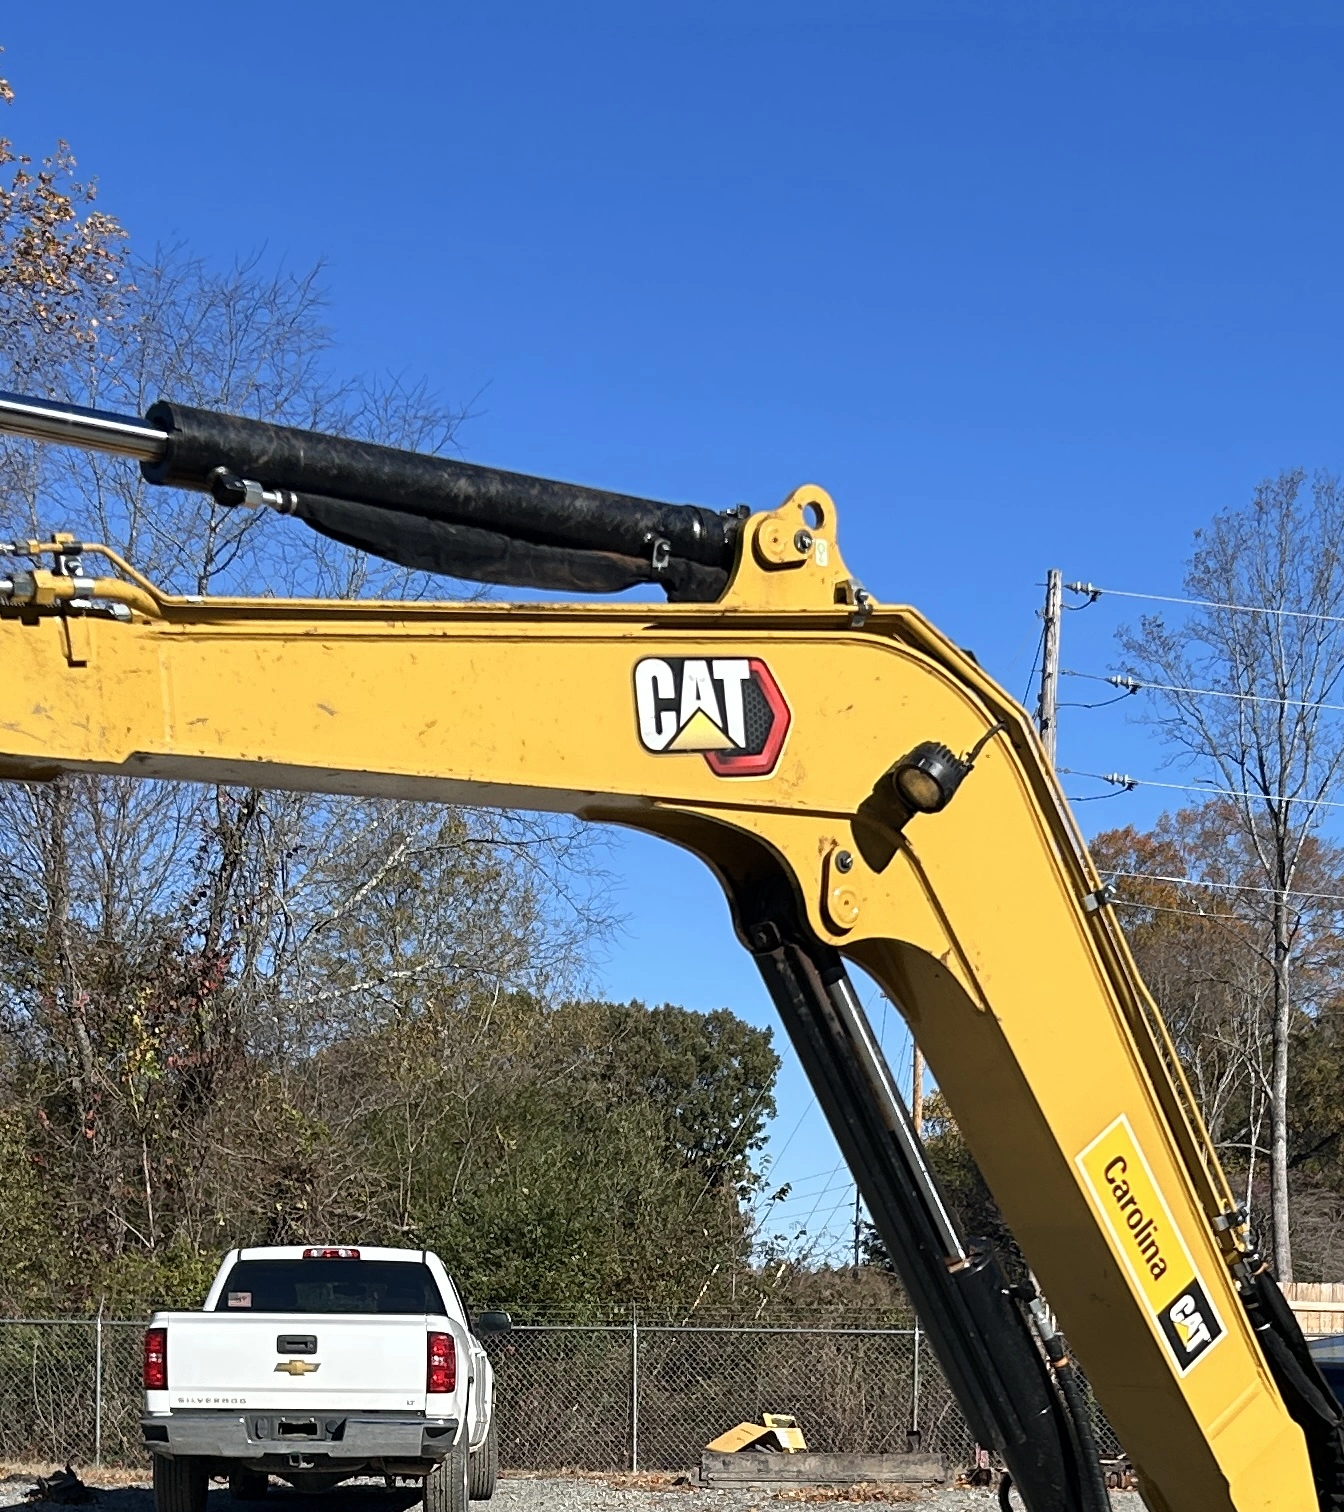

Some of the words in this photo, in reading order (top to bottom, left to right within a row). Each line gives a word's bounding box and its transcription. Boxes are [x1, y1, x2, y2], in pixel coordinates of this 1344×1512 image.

[635, 658, 751, 751] CAT
[1103, 1154, 1168, 1283] Carolina
[1168, 1293, 1213, 1353] CAT
